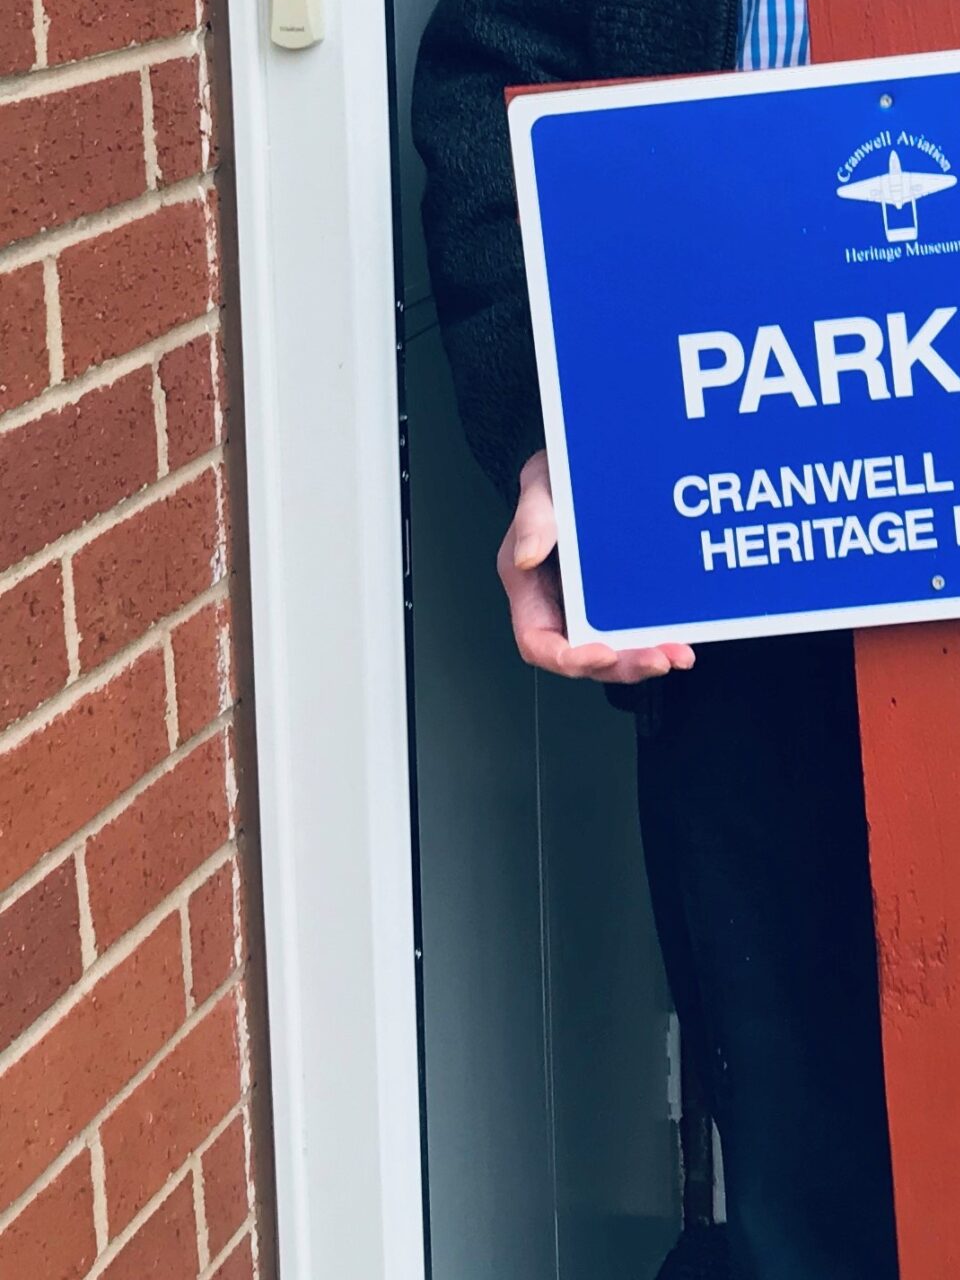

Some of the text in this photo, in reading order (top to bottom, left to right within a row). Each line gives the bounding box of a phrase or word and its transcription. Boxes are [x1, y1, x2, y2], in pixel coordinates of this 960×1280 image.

[837, 130, 952, 182] Cranwell Aviation
[845, 245, 902, 263] Heritage
[673, 452, 953, 518] CRANWELL
[700, 508, 937, 571] HERITAGE
